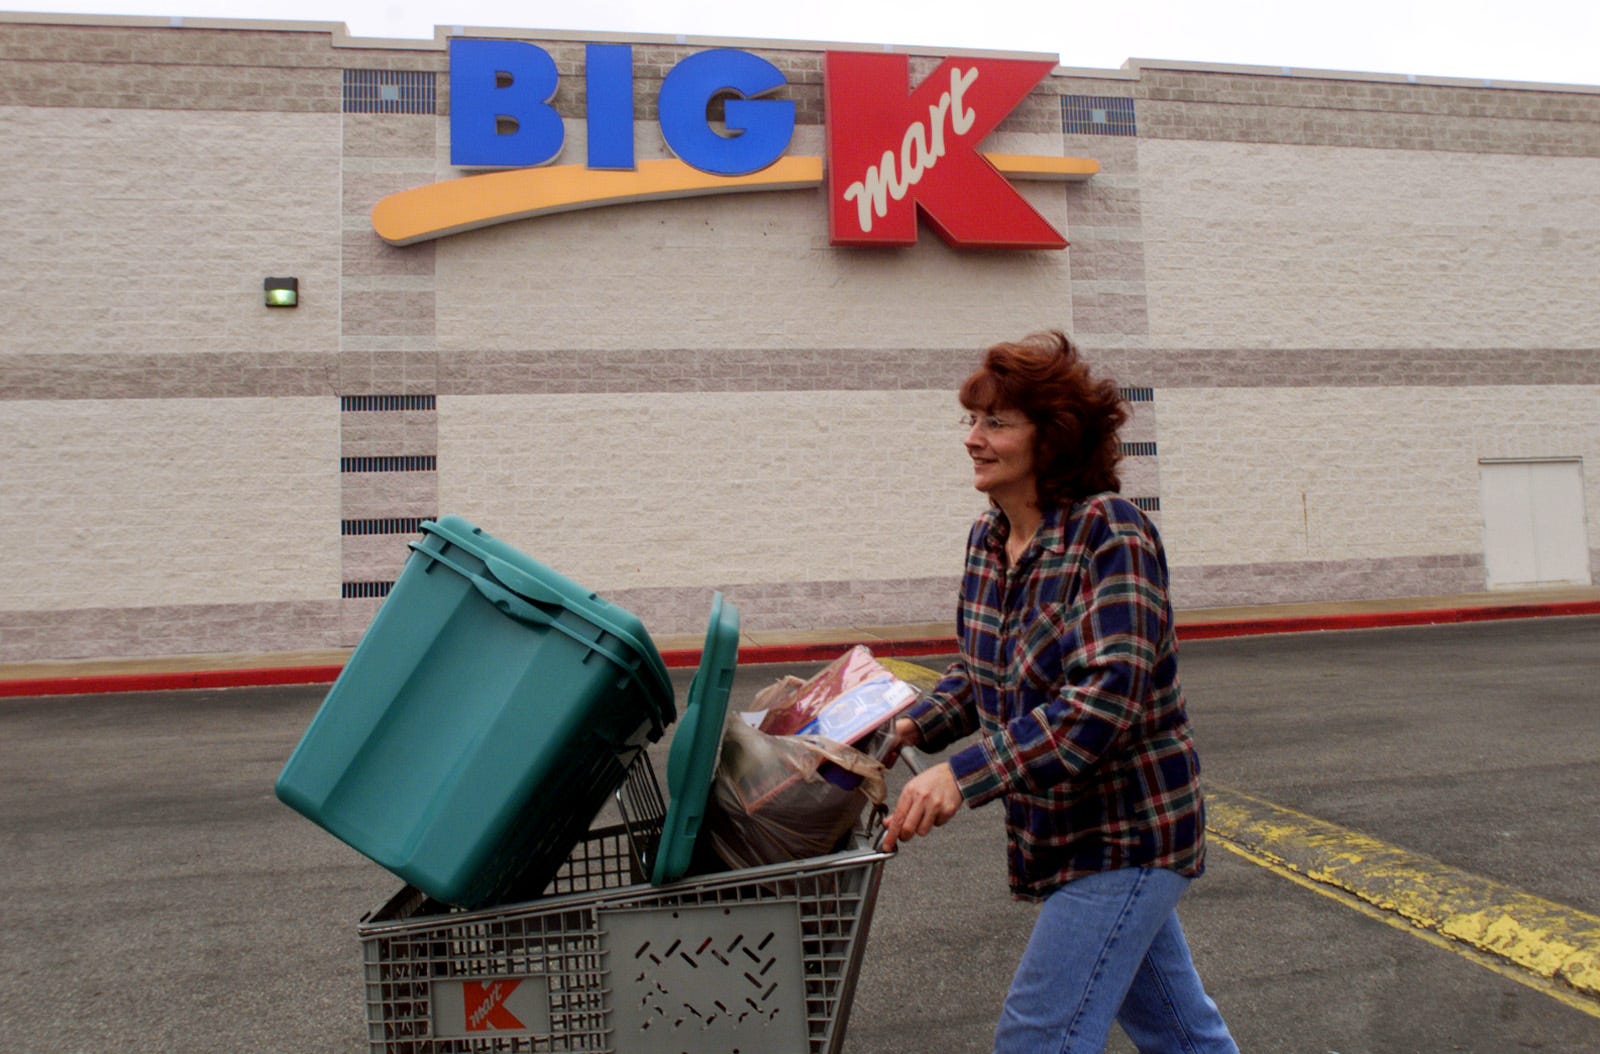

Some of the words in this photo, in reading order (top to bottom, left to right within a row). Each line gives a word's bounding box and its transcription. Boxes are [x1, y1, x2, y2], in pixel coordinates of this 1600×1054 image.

[450, 38, 796, 177] BIG
[825, 50, 1069, 248] K
[844, 67, 978, 232] mart
[463, 979, 527, 1032] K
[469, 983, 502, 1029] mart
